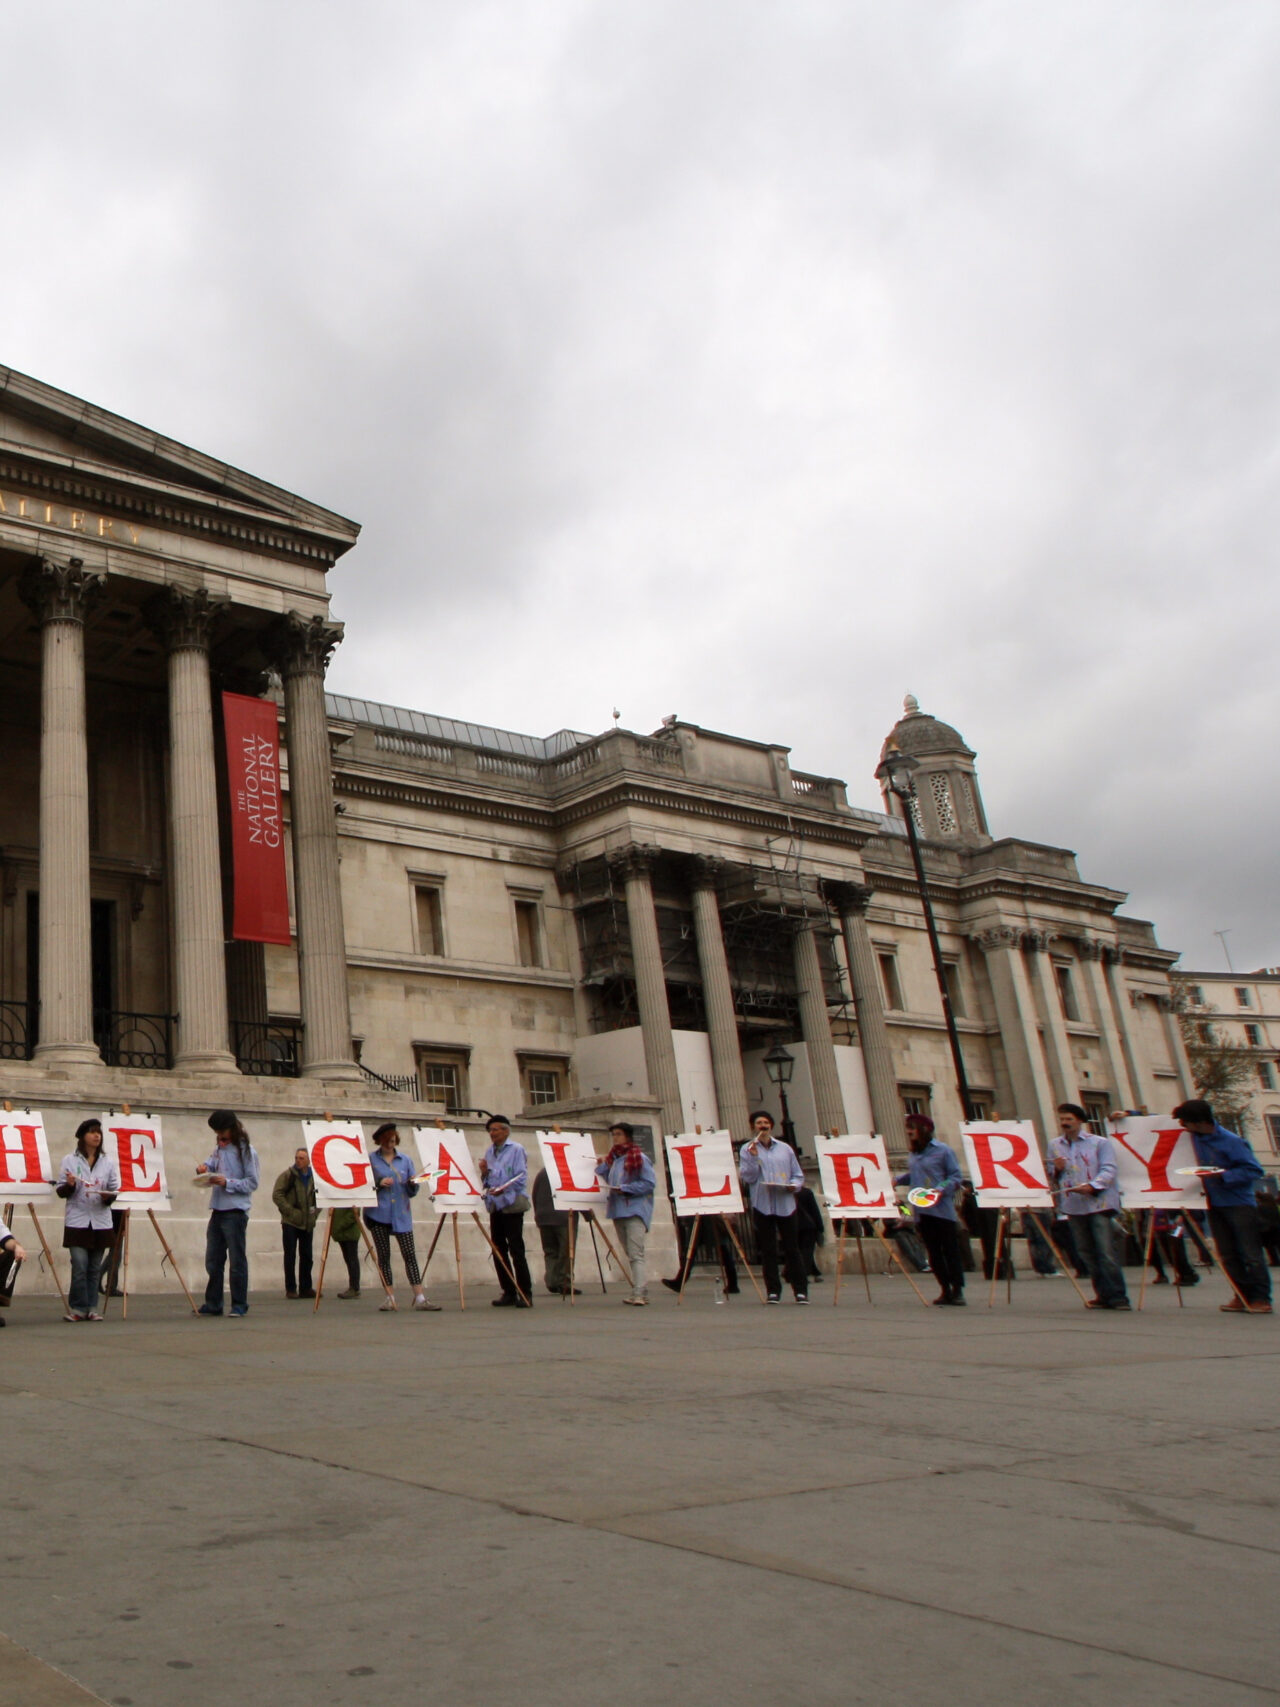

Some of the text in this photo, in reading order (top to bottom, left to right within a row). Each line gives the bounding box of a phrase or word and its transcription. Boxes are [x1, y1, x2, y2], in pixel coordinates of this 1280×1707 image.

[238, 789, 246, 812] THE
[242, 733, 263, 845] NATIONAL
[257, 735, 280, 848] GALLERY
